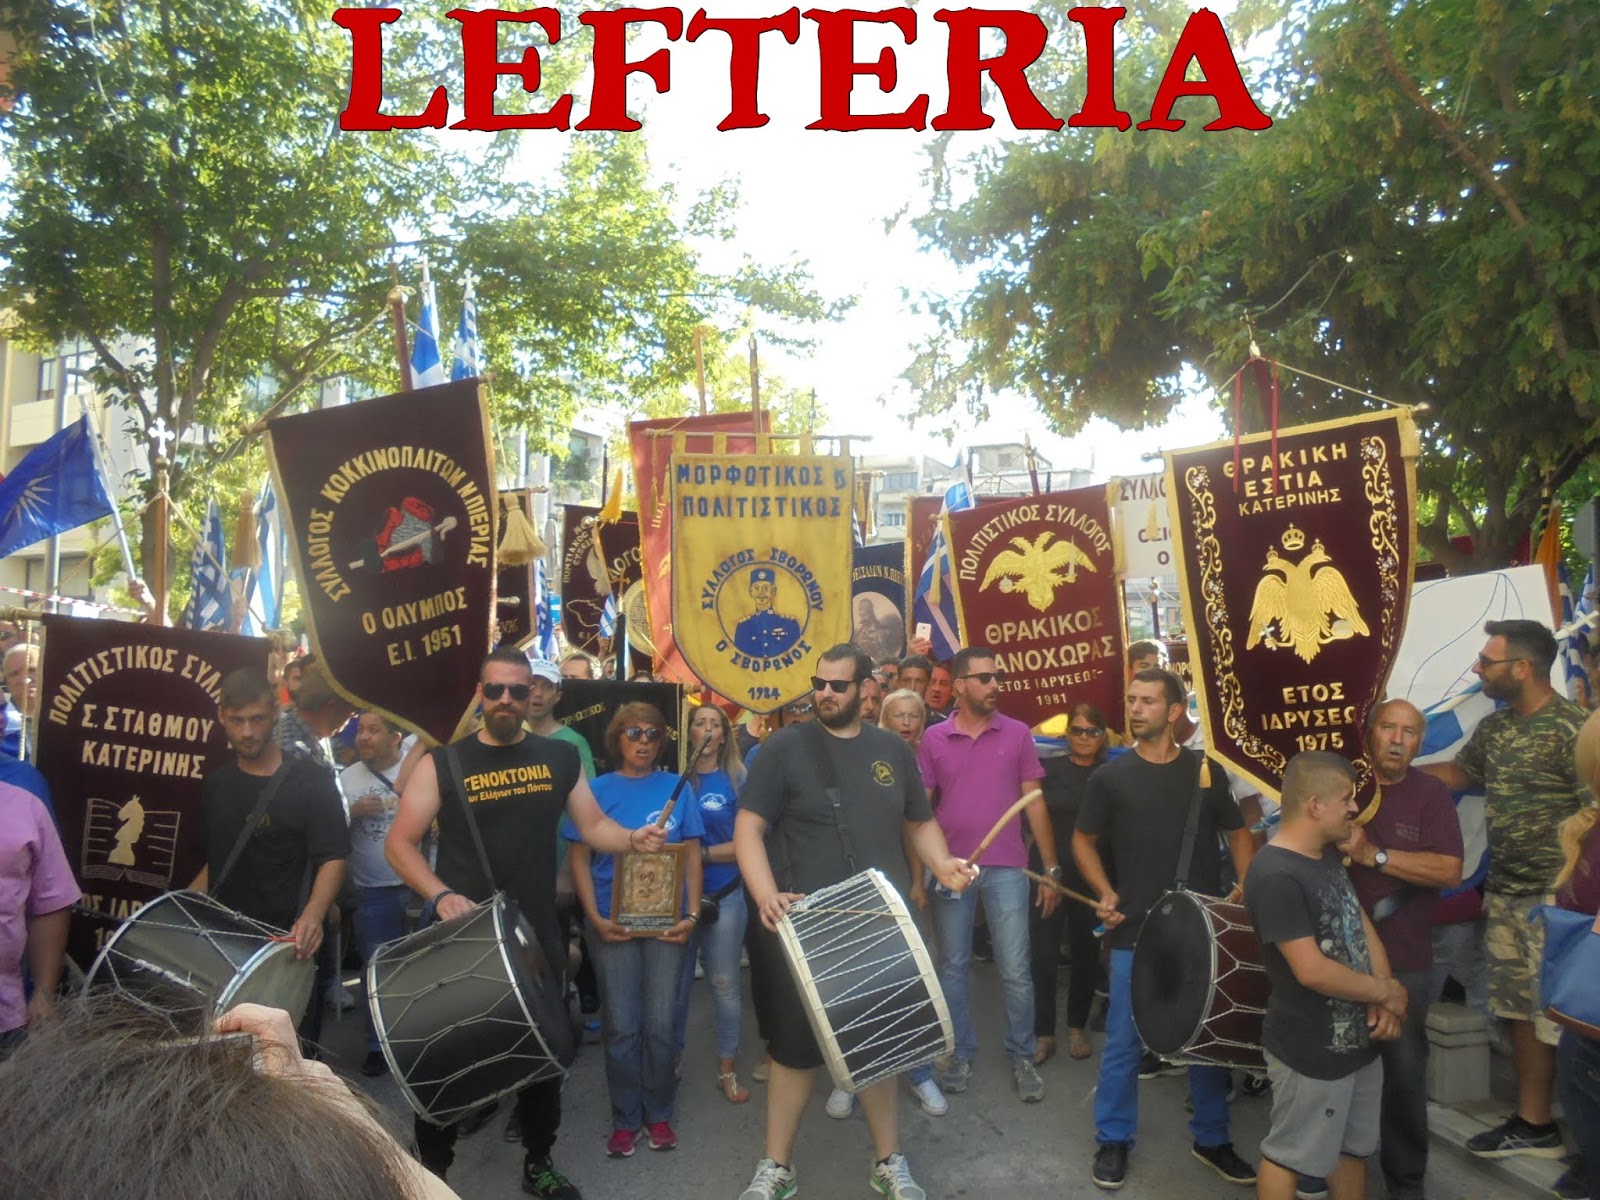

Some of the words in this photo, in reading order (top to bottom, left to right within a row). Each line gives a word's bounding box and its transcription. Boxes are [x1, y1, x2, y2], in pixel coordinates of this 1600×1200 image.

[320, 446, 467, 504] ΚΟΚΚΙΝΟΠΛΙΤΩΝ
[677, 463, 824, 487] ΜΟΡΦΩΤΙΚΟΣ
[1223, 442, 1347, 479] ΘΡΑΚΙΚΗ
[1238, 488, 1342, 517] ΚΑΤΕΡΙΝΗΣ
[1244, 470, 1323, 498] ΕΣΤΙΑ
[683, 496, 841, 519] ΠΟΛΙΤΙΣΤΙΚΟΣ
[307, 507, 352, 603] ΣΥΛΛΟΓΟΣ
[959, 504, 1041, 581] ΠΟΛΙΤΙΣΤΙΚΟΣ
[1045, 504, 1111, 556] ΣΥΛΛΟΓΟΣ
[701, 548, 755, 610] ΣΥΛΛΟΓΟΣ
[769, 546, 824, 612] ΣΒΟΡΩΝΟΥ
[362, 612, 376, 634] Ο
[382, 587, 467, 630] ΟΛΥΜΠΟΣ
[985, 606, 1103, 645] ΘΡΑΚΙΚΟΣ
[422, 624, 462, 656] 1951
[730, 640, 812, 673] ΣΒΟΡΩΝΟΣ
[49, 645, 178, 726] ΠΟΛΙΤΙΣΤΙΚΟΣ
[1036, 692, 1068, 706] 1981
[1282, 682, 1345, 705] ΕΤΟΣ
[104, 705, 214, 743] ΣΤΑΘΜΟΥ
[1295, 732, 1344, 752] 1975
[82, 740, 206, 779] ΚΑΤΕΡΙΝΗΣ
